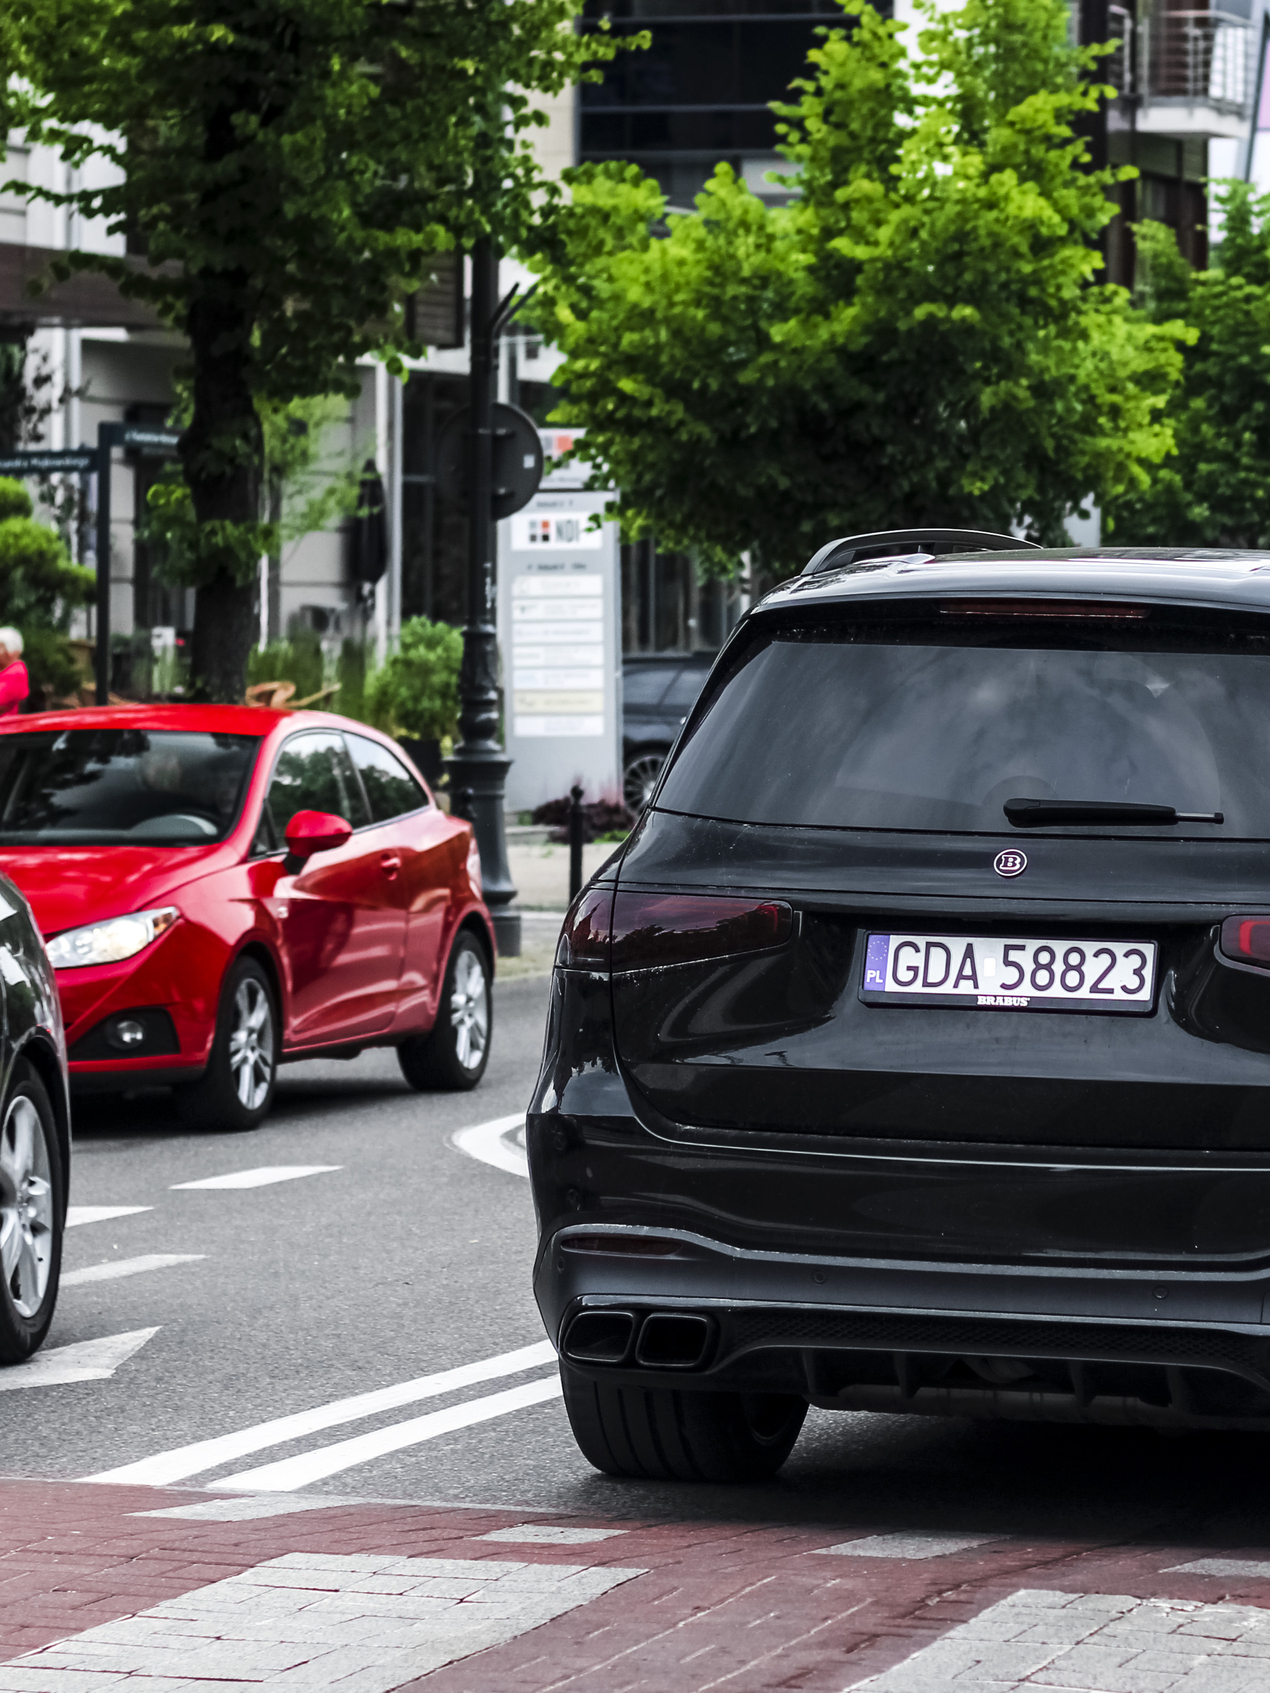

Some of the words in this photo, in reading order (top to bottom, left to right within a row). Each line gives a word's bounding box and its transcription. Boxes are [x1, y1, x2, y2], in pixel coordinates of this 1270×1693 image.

[892, 941, 979, 989] GDA
[1000, 944, 1147, 994] 58823
[866, 970, 883, 983] PL
[977, 995, 1030, 1007] BRABUS
